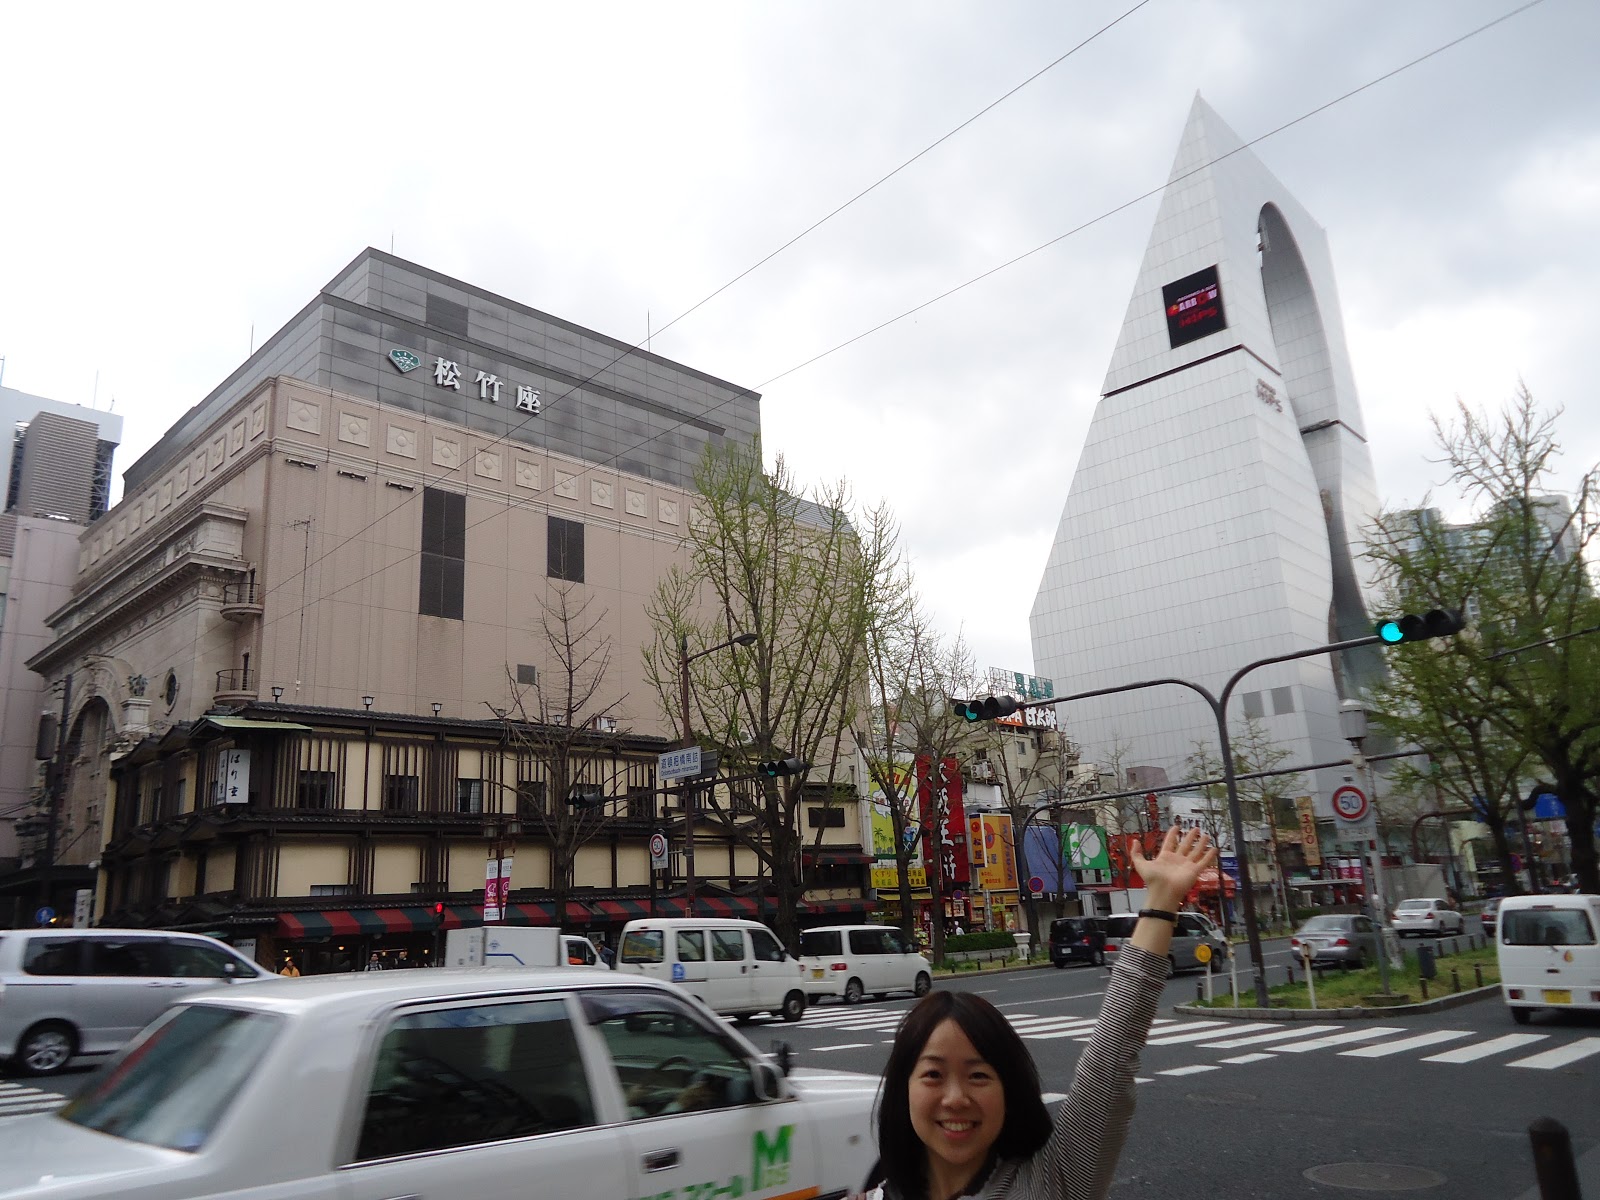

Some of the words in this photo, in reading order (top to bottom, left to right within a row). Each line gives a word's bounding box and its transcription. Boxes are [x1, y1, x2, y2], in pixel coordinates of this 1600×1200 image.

[434, 356, 541, 415] 松竹座
[229, 754, 241, 797] はり重
[1340, 795, 1360, 811] 50
[973, 837, 983, 860] 松屋
[874, 870, 891, 878] くすり
